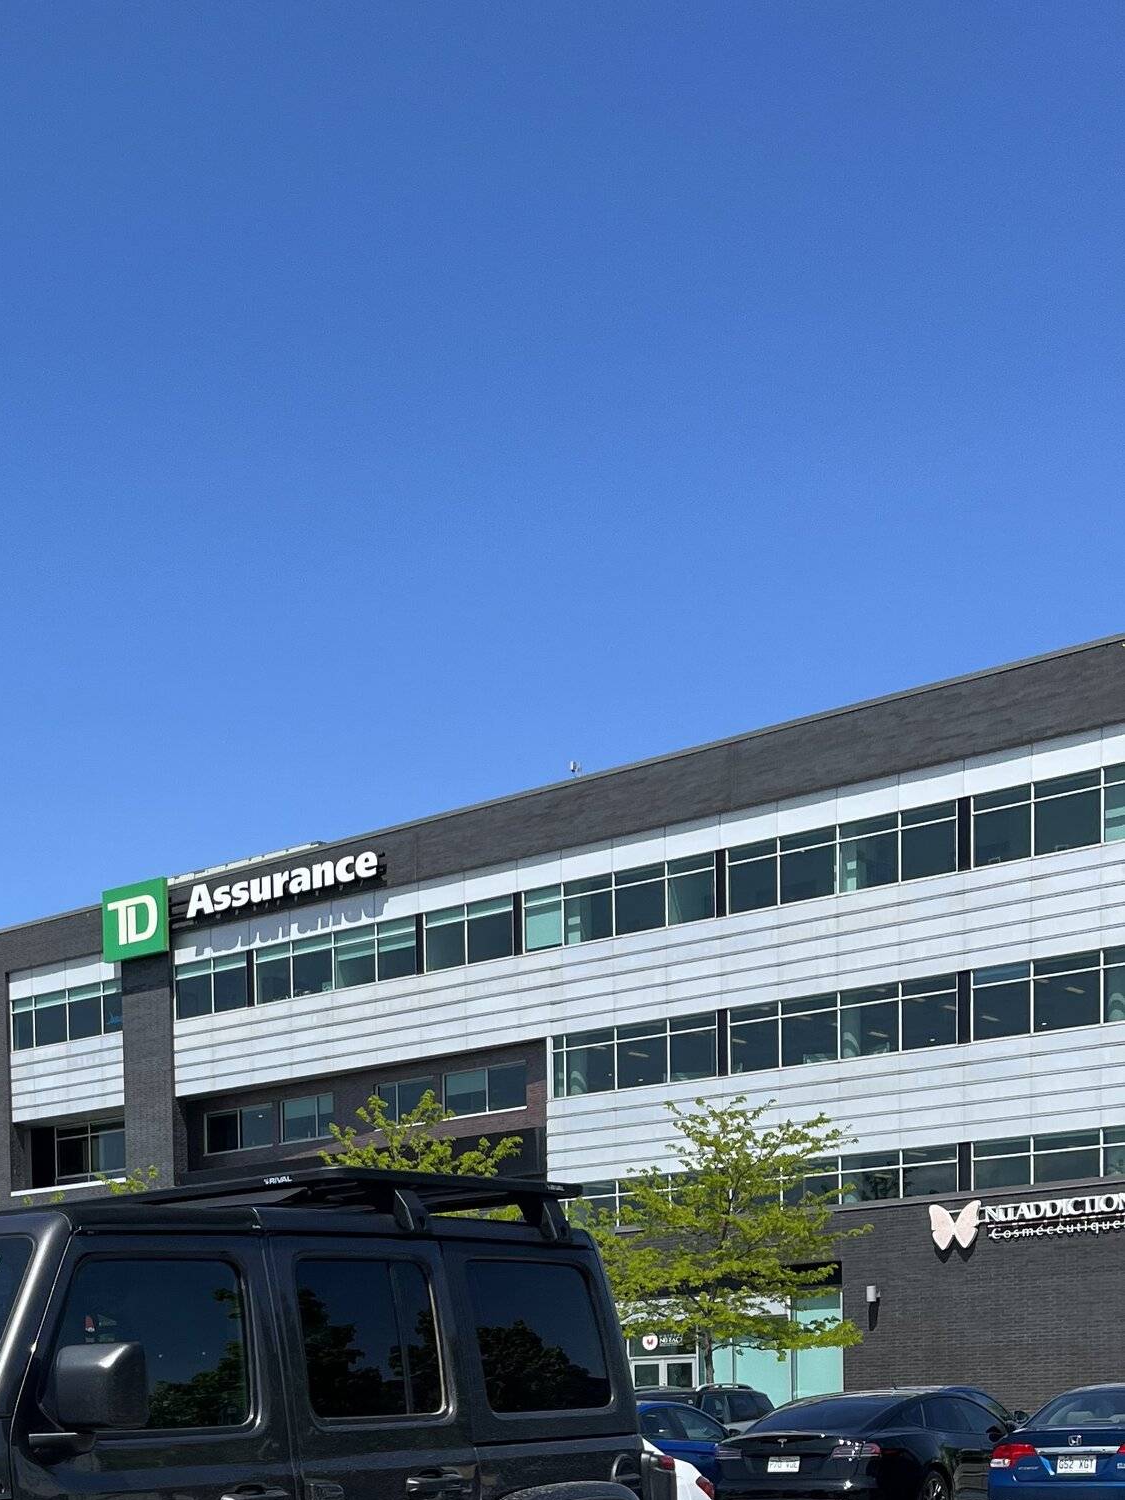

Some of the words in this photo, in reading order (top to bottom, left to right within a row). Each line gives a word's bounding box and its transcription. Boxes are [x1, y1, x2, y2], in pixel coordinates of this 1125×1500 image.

[107, 894, 158, 946] TD
[186, 850, 378, 919] Assurance
[269, 1175, 293, 1185] RIVAL
[991, 1219, 1125, 1239] Cosméceutique
